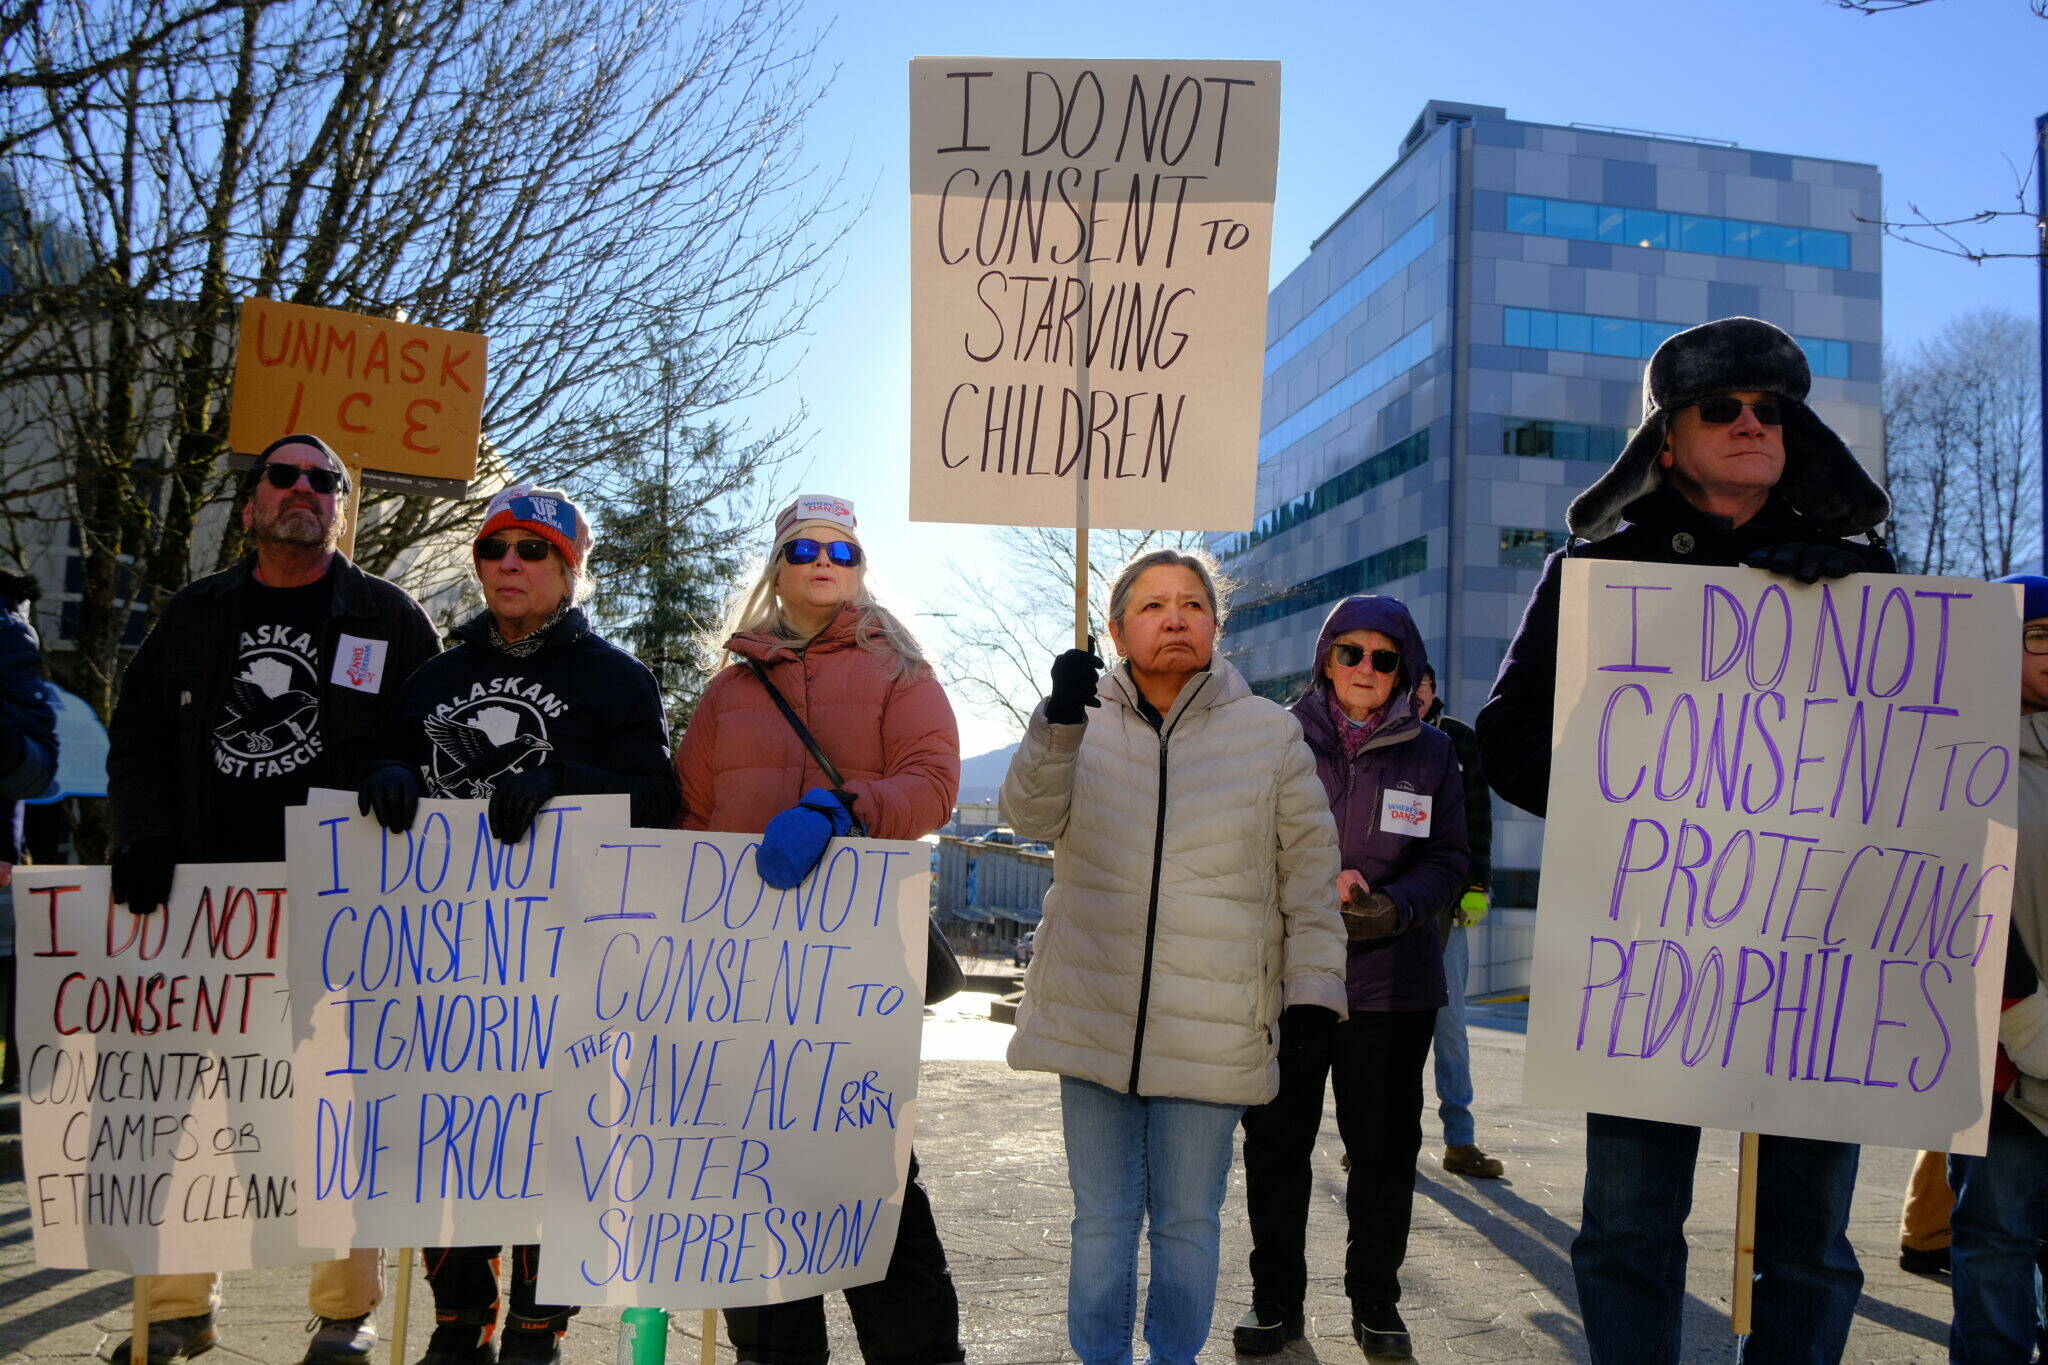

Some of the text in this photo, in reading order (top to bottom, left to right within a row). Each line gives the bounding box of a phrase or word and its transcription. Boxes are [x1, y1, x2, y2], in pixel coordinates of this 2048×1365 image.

[937, 70, 1256, 167] I DO NOT
[938, 167, 1250, 269] CONSENT TO
[257, 311, 472, 393] UNMASK
[965, 270, 1195, 372] STARVING
[283, 381, 443, 455] ICE
[941, 382, 1185, 483] CHILDREN
[529, 496, 558, 507] STAND
[532, 513, 563, 531] ALASKA
[533, 501, 557, 518] UP
[1597, 583, 1973, 704] I DO NOT
[436, 676, 569, 719] ALASKANS
[254, 732, 323, 779] FASCIS
[1597, 682, 2010, 828] CONSENT TO
[318, 806, 582, 896] I DO NOT
[583, 841, 910, 933] I DO NOT
[1608, 817, 2009, 967] PROTECTING
[28, 885, 287, 960] I DO NOT
[321, 896, 549, 993] CONSENT
[53, 972, 275, 1035] CONSENT
[595, 932, 905, 1027] CONSENT TO
[1576, 935, 1952, 1092] PEDOPHILES
[28, 1044, 295, 1105] CONCENTRATIO
[325, 993, 560, 1076] IGNORIN
[564, 1025, 617, 1069] THE
[742, 1037, 852, 1132] ACT
[834, 1092, 896, 1133] ANY
[840, 1070, 884, 1105] OR
[63, 1111, 260, 1162] CAMPS OR
[315, 1090, 553, 1203] DUE PROCE
[575, 1134, 773, 1204] VOTER
[38, 1172, 174, 1227] ETHNIC
[580, 1198, 882, 1287] SUPPRESSION
